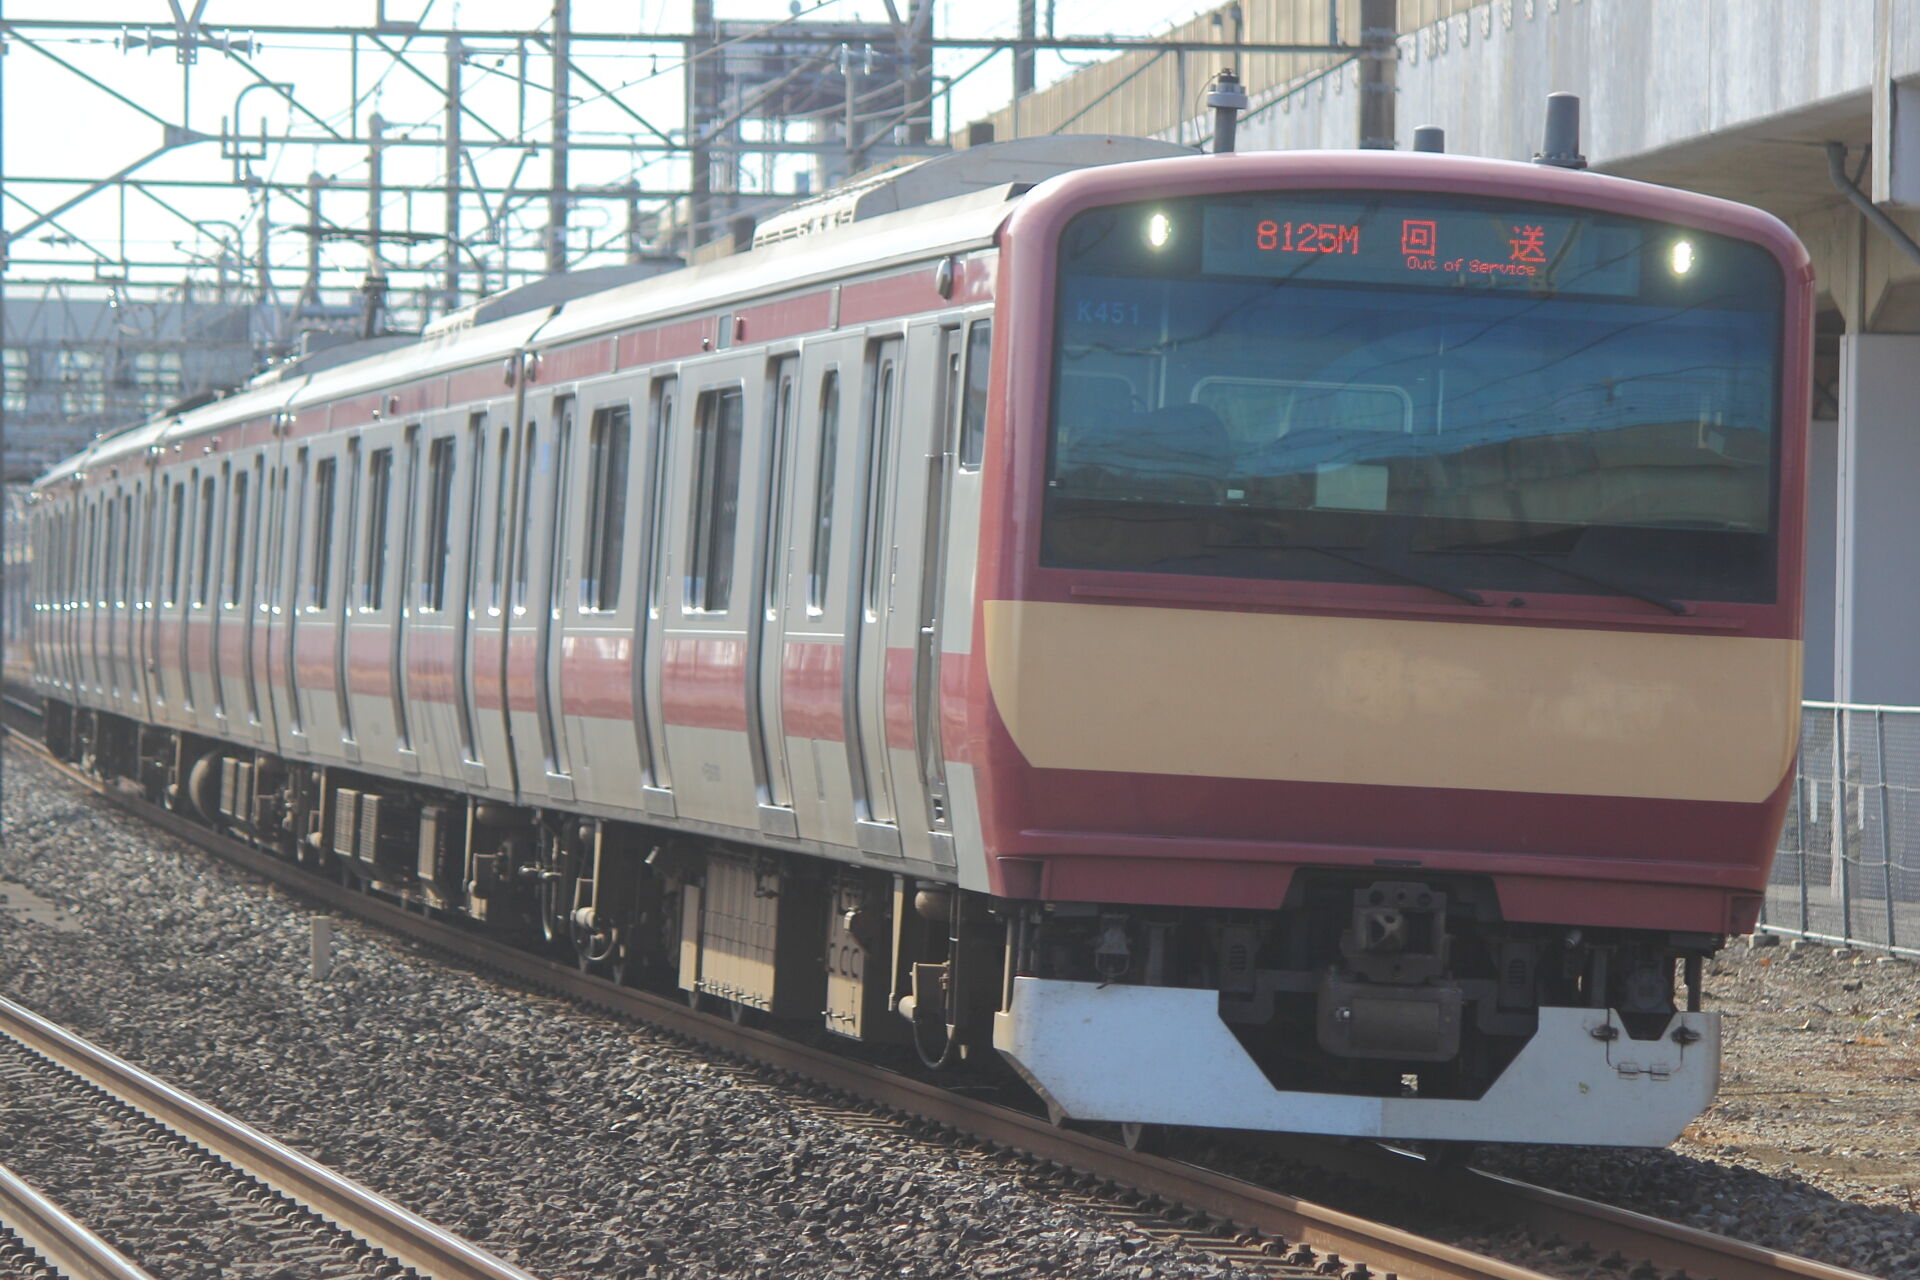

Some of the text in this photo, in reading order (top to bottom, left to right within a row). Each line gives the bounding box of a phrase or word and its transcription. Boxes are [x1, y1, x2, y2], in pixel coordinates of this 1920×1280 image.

[1257, 220, 1359, 254] 8125M
[1407, 256, 1536, 277] Out of Service
[1077, 301, 1139, 325] K451
